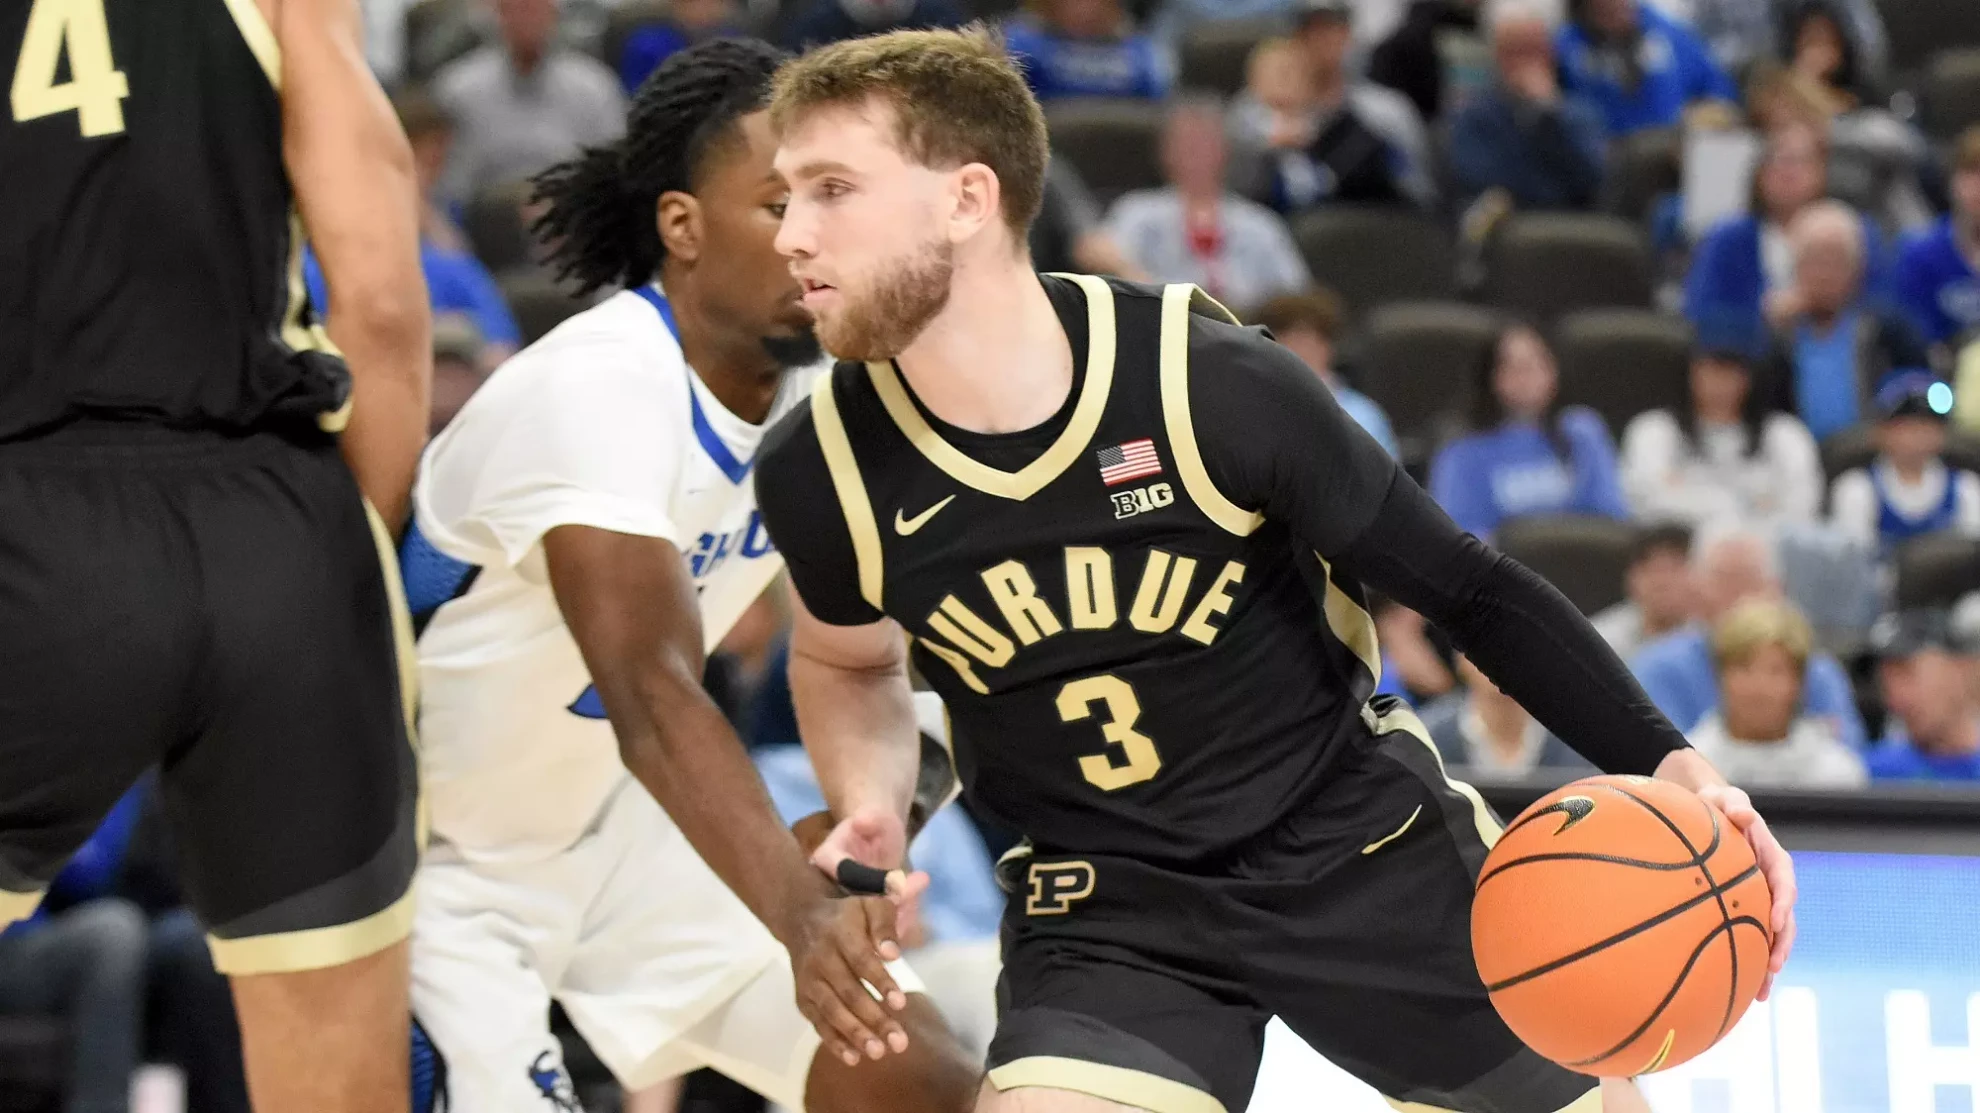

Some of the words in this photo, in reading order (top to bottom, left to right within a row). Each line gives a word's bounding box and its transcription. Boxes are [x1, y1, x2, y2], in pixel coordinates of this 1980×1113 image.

[9, 0, 130, 137] 4
[1054, 673, 1163, 792] 3
[1026, 860, 1096, 916] P
